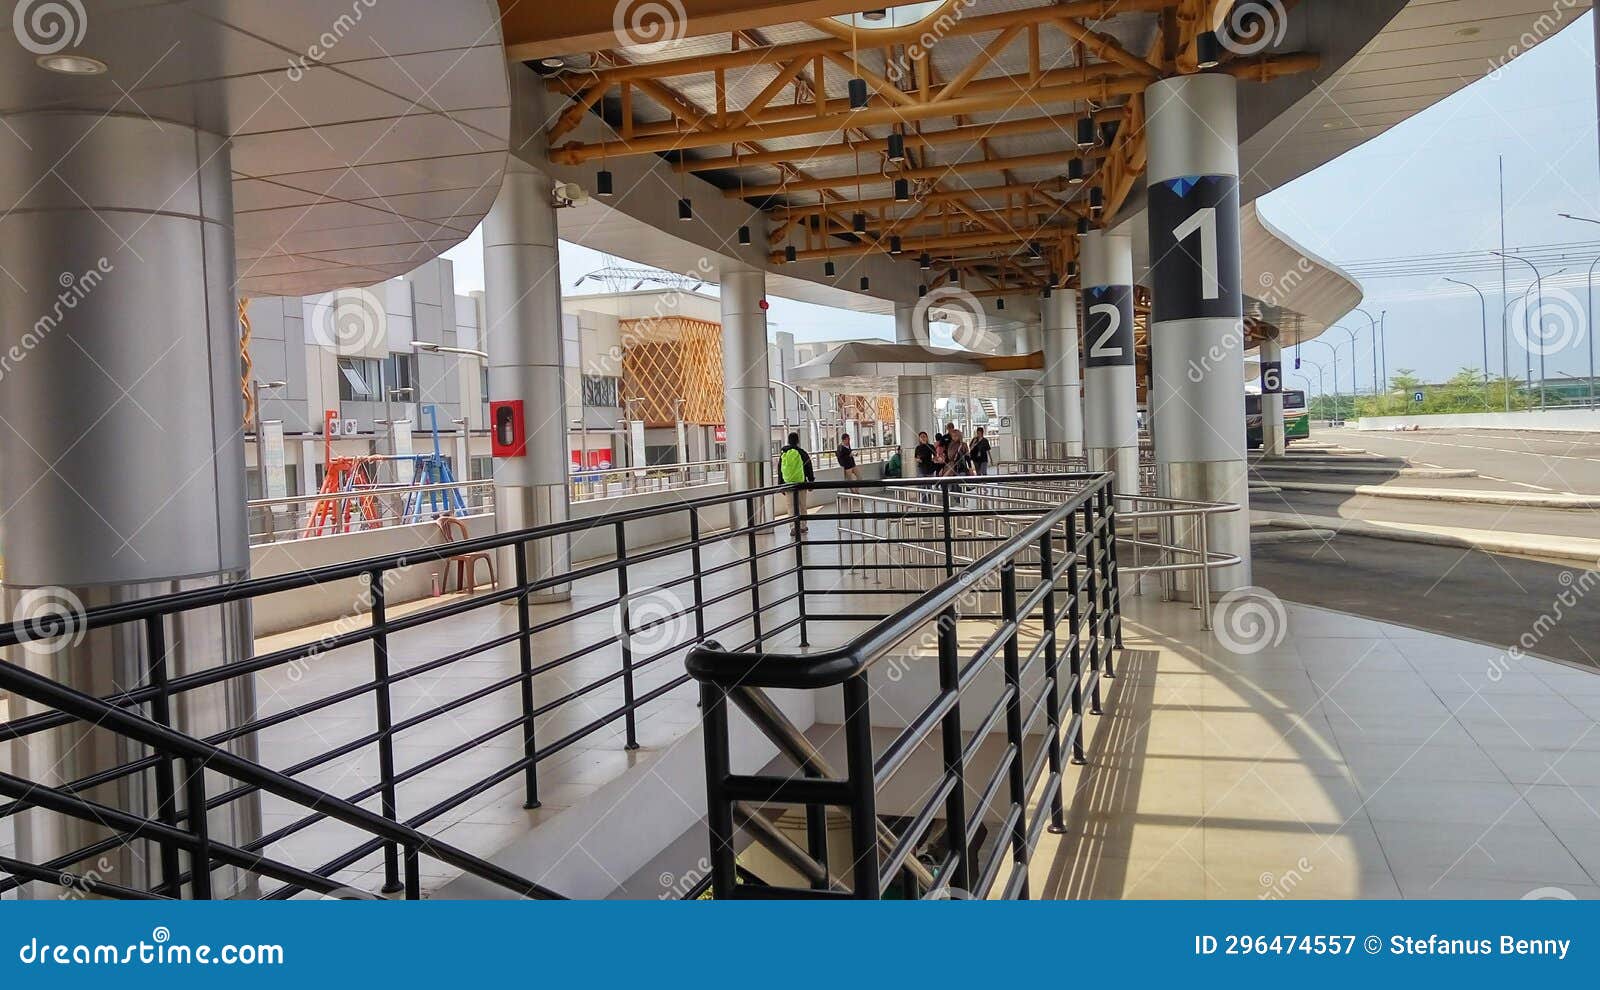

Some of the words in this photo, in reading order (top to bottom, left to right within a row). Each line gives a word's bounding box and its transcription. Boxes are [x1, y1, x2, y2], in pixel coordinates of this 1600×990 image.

[1172, 207, 1219, 300] 1
[1088, 303, 1123, 358] 2
[1264, 368, 1280, 390] 6
